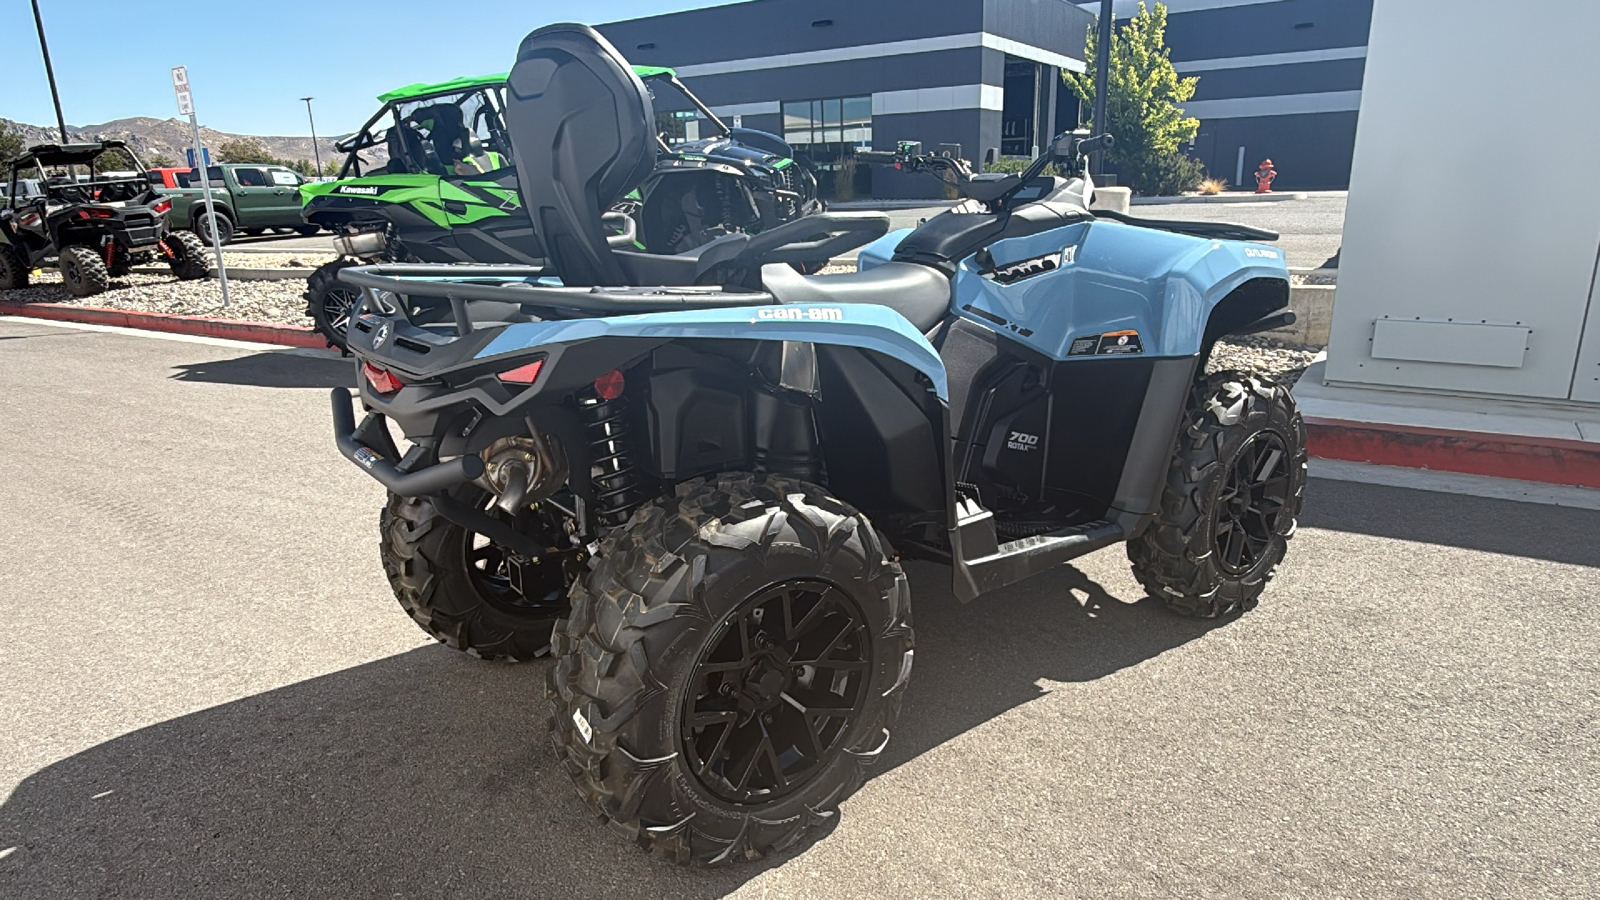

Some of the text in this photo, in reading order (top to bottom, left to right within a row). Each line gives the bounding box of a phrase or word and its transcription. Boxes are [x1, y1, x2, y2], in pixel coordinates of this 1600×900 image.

[340, 185, 378, 195] Kawasaki
[757, 307, 843, 321] can-am
[1009, 431, 1039, 445] 700
[1007, 441, 1029, 452] ROTAX
